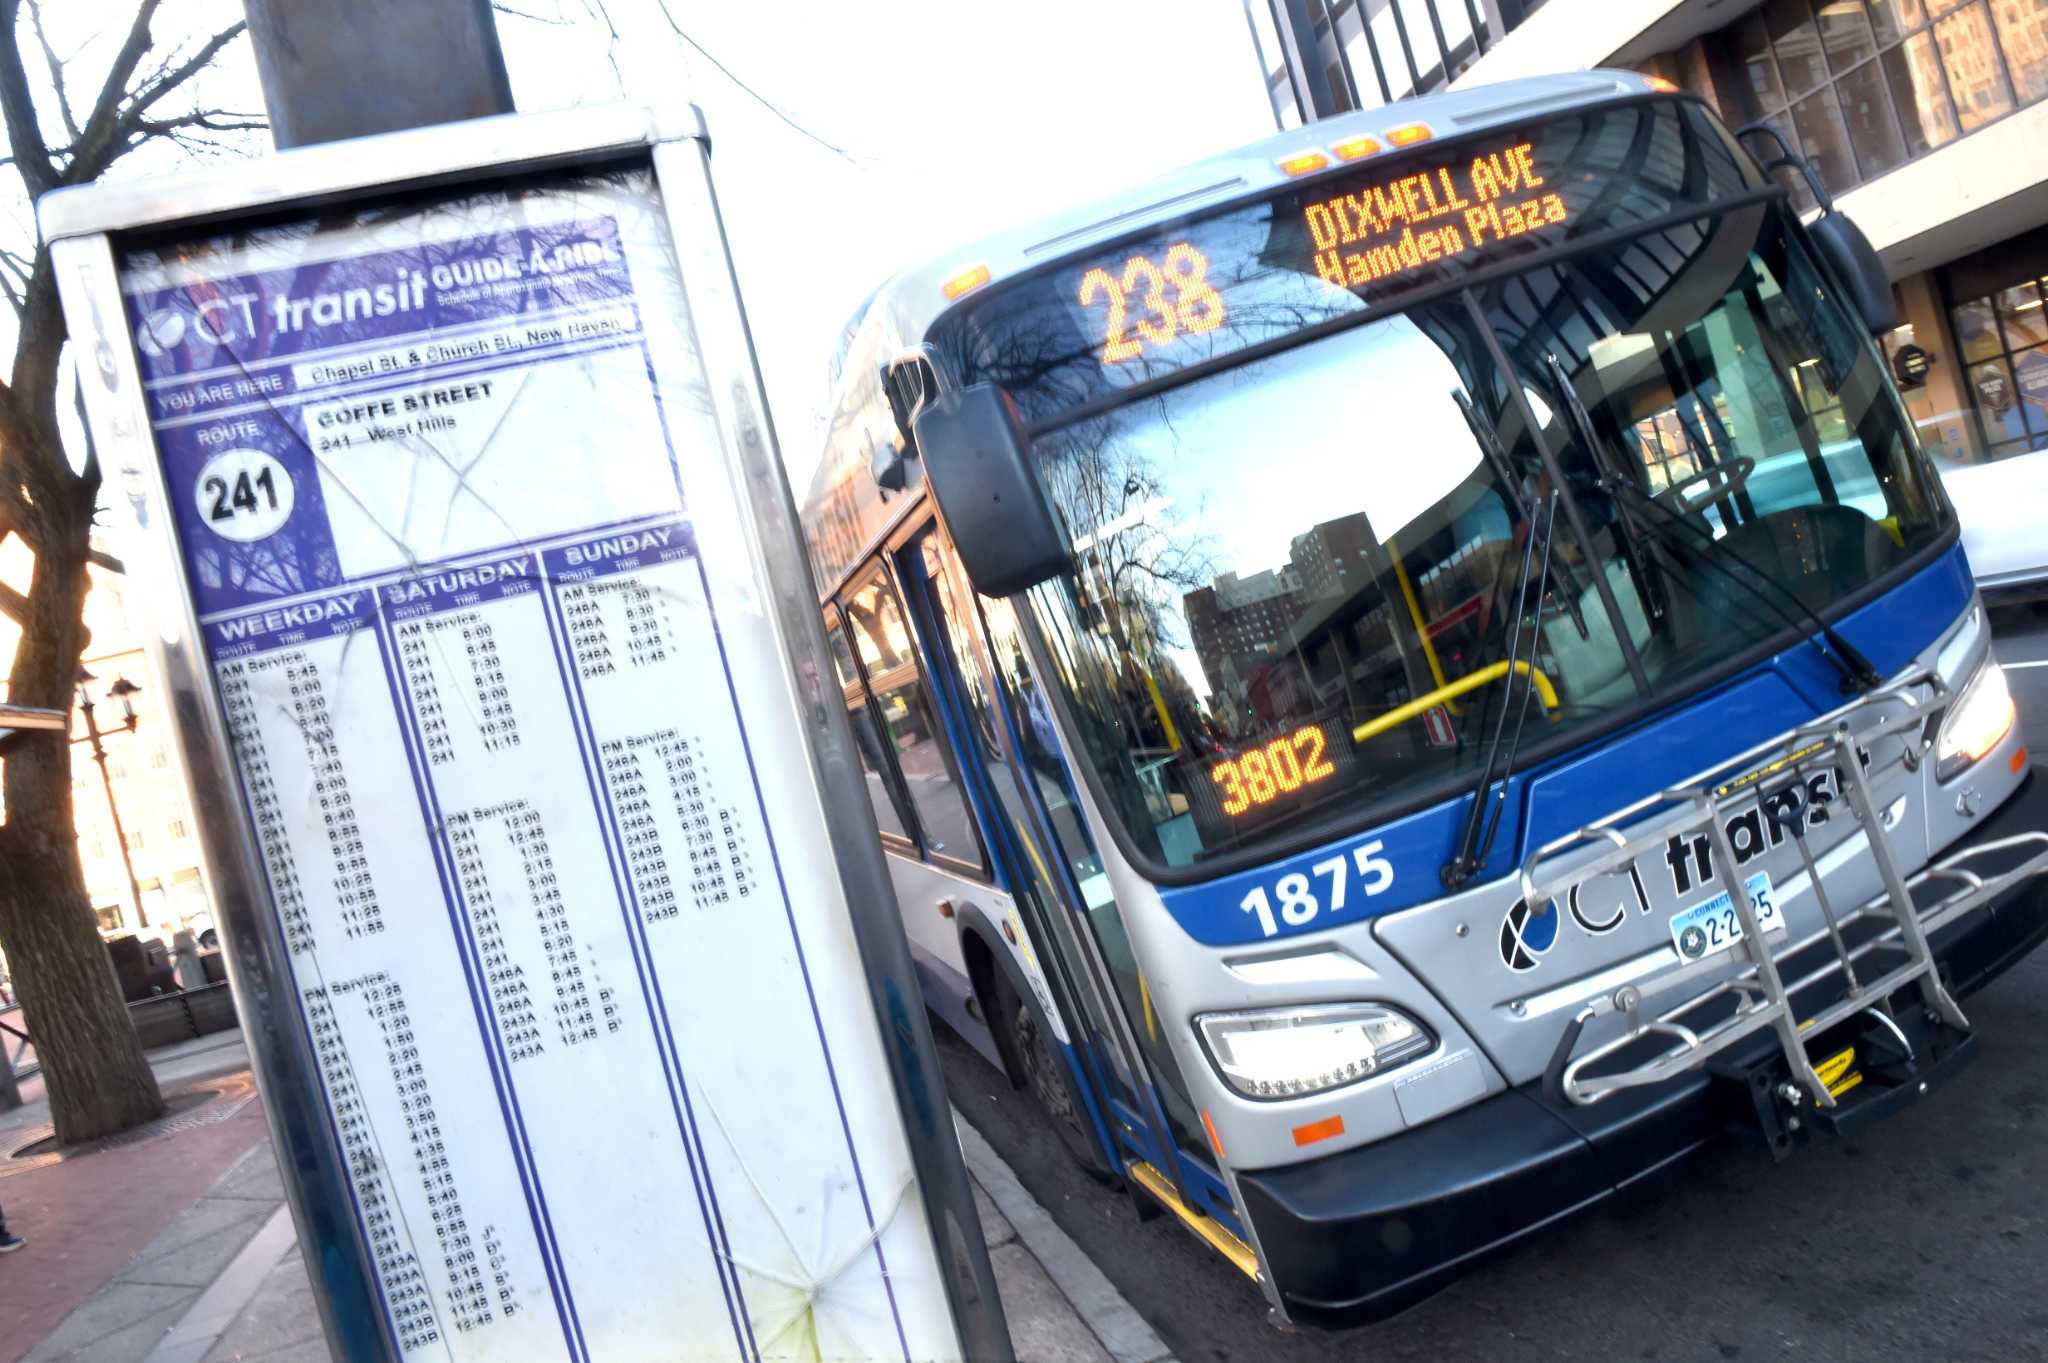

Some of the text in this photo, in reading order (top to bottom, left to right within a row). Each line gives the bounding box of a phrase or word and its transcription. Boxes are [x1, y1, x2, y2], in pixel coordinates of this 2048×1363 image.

[1304, 143, 1544, 250] DIXWELL AVE
[1314, 194, 1568, 289] Hamden Plaza
[193, 268, 428, 346] CT transit
[1079, 242, 1224, 364] 238
[312, 358, 374, 384] Chapel
[408, 349, 422, 366] &
[426, 338, 490, 363] Church
[527, 327, 564, 345] New
[568, 319, 621, 339] Haven
[157, 374, 285, 411] YOU ARE HERE
[403, 380, 493, 412] STREET
[196, 420, 262, 446] ROUTE
[320, 414, 457, 452] 241 West Hills
[204, 463, 278, 522] 241
[564, 527, 672, 565] SUNDAY
[387, 558, 530, 605] SATURDAY
[563, 587, 584, 602] AM
[217, 593, 360, 642] WEEKDAY
[400, 624, 421, 638] AM
[221, 663, 244, 680] AM
[1212, 725, 1334, 816] 3802
[1239, 839, 1394, 938] 1875
